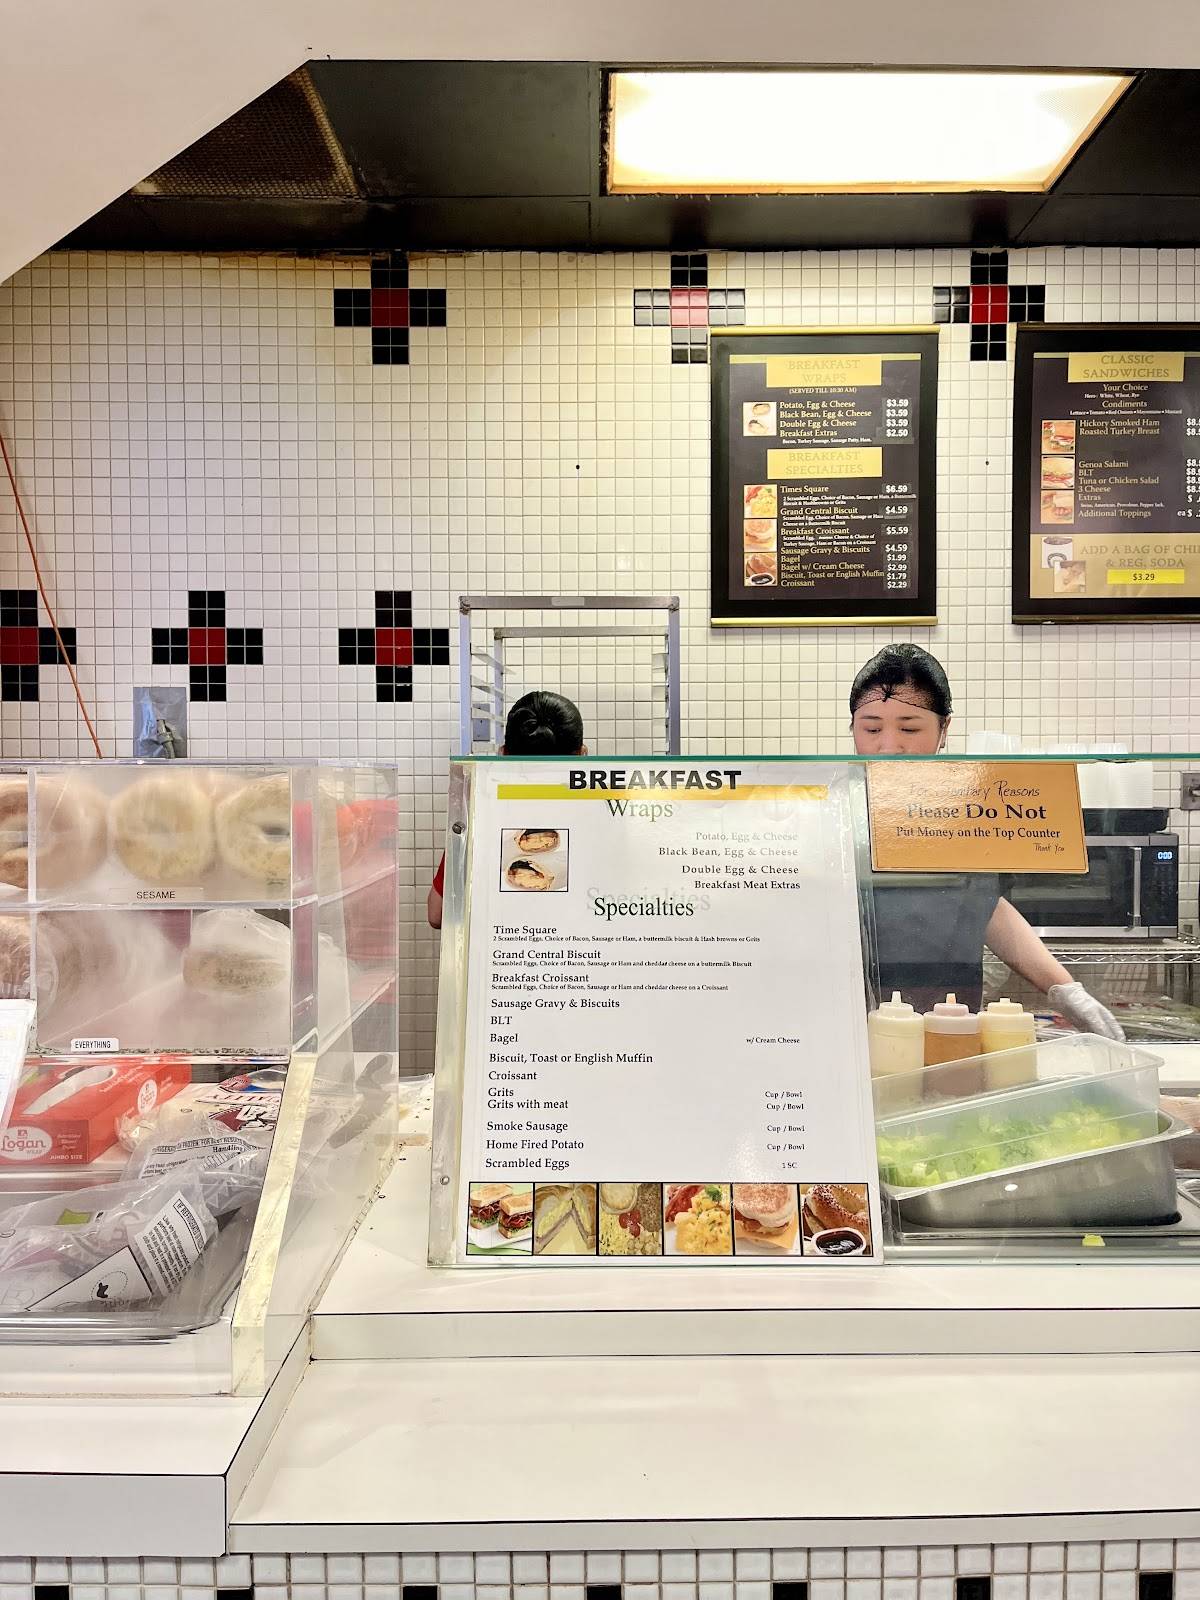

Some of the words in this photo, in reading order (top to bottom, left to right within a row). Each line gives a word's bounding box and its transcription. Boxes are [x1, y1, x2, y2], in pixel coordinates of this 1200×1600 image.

[788, 359, 861, 370] BREAKFAST
[1100, 355, 1154, 364] CLASSIC
[802, 373, 847, 383] WRAPS
[1083, 368, 1169, 378] SANDWICHES
[780, 401, 804, 409] Potato,
[806, 400, 820, 410] Egg
[830, 400, 856, 408] Cheese
[886, 398, 908, 408] $3.59
[1102, 400, 1147, 408] Condiments
[780, 410, 800, 418] Black
[801, 410, 820, 418] Bean,
[822, 410, 835, 419] Egg
[846, 409, 872, 417] Cheese
[886, 408, 908, 417] $3.59
[780, 420, 806, 428] Double
[807, 420, 821, 429] Egg
[831, 419, 856, 427] Cheese
[886, 418, 908, 427] $3.59
[1079, 420, 1108, 428] Hickory
[780, 429, 813, 437] Breakfast
[815, 429, 837, 437] Extras
[886, 428, 908, 437] $2.50
[1110, 428, 1135, 436] Turkey
[788, 452, 861, 462] BREAKFAST
[786, 464, 863, 474] SPECIALTIES
[804, 485, 829, 494] Square
[886, 485, 908, 493] $6.59
[805, 507, 832, 515] Central
[885, 506, 908, 514] $4.59
[1118, 510, 1151, 518] Toppings
[780, 527, 814, 535] Breakfast
[886, 526, 908, 534] $5.59
[780, 547, 809, 556] Sausage
[811, 547, 832, 555] Gravy
[885, 544, 908, 552] $4.59
[1080, 546, 1108, 554] ADD
[1112, 546, 1120, 554] A
[1124, 545, 1150, 554] BAG
[1154, 545, 1170, 554] OF
[1174, 545, 1200, 554] CHI
[781, 555, 800, 564] Bagel
[887, 554, 906, 562] $1.99
[1106, 559, 1114, 567] &
[1119, 559, 1147, 567] REG.
[1150, 558, 1185, 567] SODA
[781, 563, 800, 572] Bagel
[813, 562, 837, 570] Cream
[887, 563, 907, 572] $2.99
[781, 571, 806, 579] Biscuit,
[836, 570, 860, 579] English
[887, 572, 906, 580] $1.79
[781, 579, 814, 587] Croissant
[887, 581, 907, 589] $2.29
[569, 770, 742, 790] BREAKFAST
[994, 780, 1040, 803] Reasons
[605, 798, 673, 822] Wraps
[906, 804, 959, 819] Please
[966, 804, 998, 819] Do
[1006, 804, 1046, 819] Not
[696, 832, 728, 842] Potato,
[731, 832, 750, 843] Egg
[752, 832, 761, 841] &
[763, 832, 798, 841] Cheese
[896, 826, 914, 837] Put
[916, 827, 954, 840] Money
[974, 828, 990, 837] the
[993, 828, 1014, 840] Top
[1017, 828, 1060, 838] Counter
[659, 847, 688, 856] Black
[692, 847, 721, 858] Bean,
[725, 847, 744, 858] Egg
[748, 848, 756, 856] &
[760, 847, 799, 856] Cheese
[682, 865, 721, 874] Double
[725, 865, 745, 876] Egg
[748, 866, 757, 874] &
[761, 865, 799, 874] Cheese
[694, 880, 740, 889] Breakfast
[743, 880, 767, 889] Meat
[770, 880, 801, 890] Extras
[136, 891, 176, 899] SESAME
[594, 897, 694, 921] Specialties
[494, 926, 519, 934] Time
[522, 926, 557, 936] Square
[493, 950, 525, 959] Grand
[528, 950, 564, 959] Central
[567, 950, 601, 959] Biscuit
[492, 974, 539, 983] Breakfast
[542, 974, 589, 983] Croissant
[491, 999, 532, 1010] Sausage
[535, 999, 566, 1010] Gravy
[569, 999, 578, 1008] &
[580, 999, 620, 1008] Biscuits
[490, 1016, 512, 1025] BLT
[490, 1034, 518, 1044] Bagel
[489, 1054, 527, 1064] Biscuit,
[530, 1054, 558, 1063] Toast
[574, 1054, 613, 1065] English
[616, 1054, 653, 1063] Muffin
[488, 1071, 537, 1080] Croissant
[488, 1088, 514, 1097] Grits
[487, 1100, 514, 1109] Grits
[517, 1100, 541, 1109] with
[543, 1100, 568, 1109] meat
[487, 1121, 523, 1131] Smoke
[526, 1122, 568, 1133] Sausage
[486, 1140, 519, 1150] Home
[521, 1140, 548, 1150] Fired
[551, 1140, 584, 1150] Potato
[485, 1158, 542, 1168] Scrambled
[544, 1158, 570, 1170] Eggs
